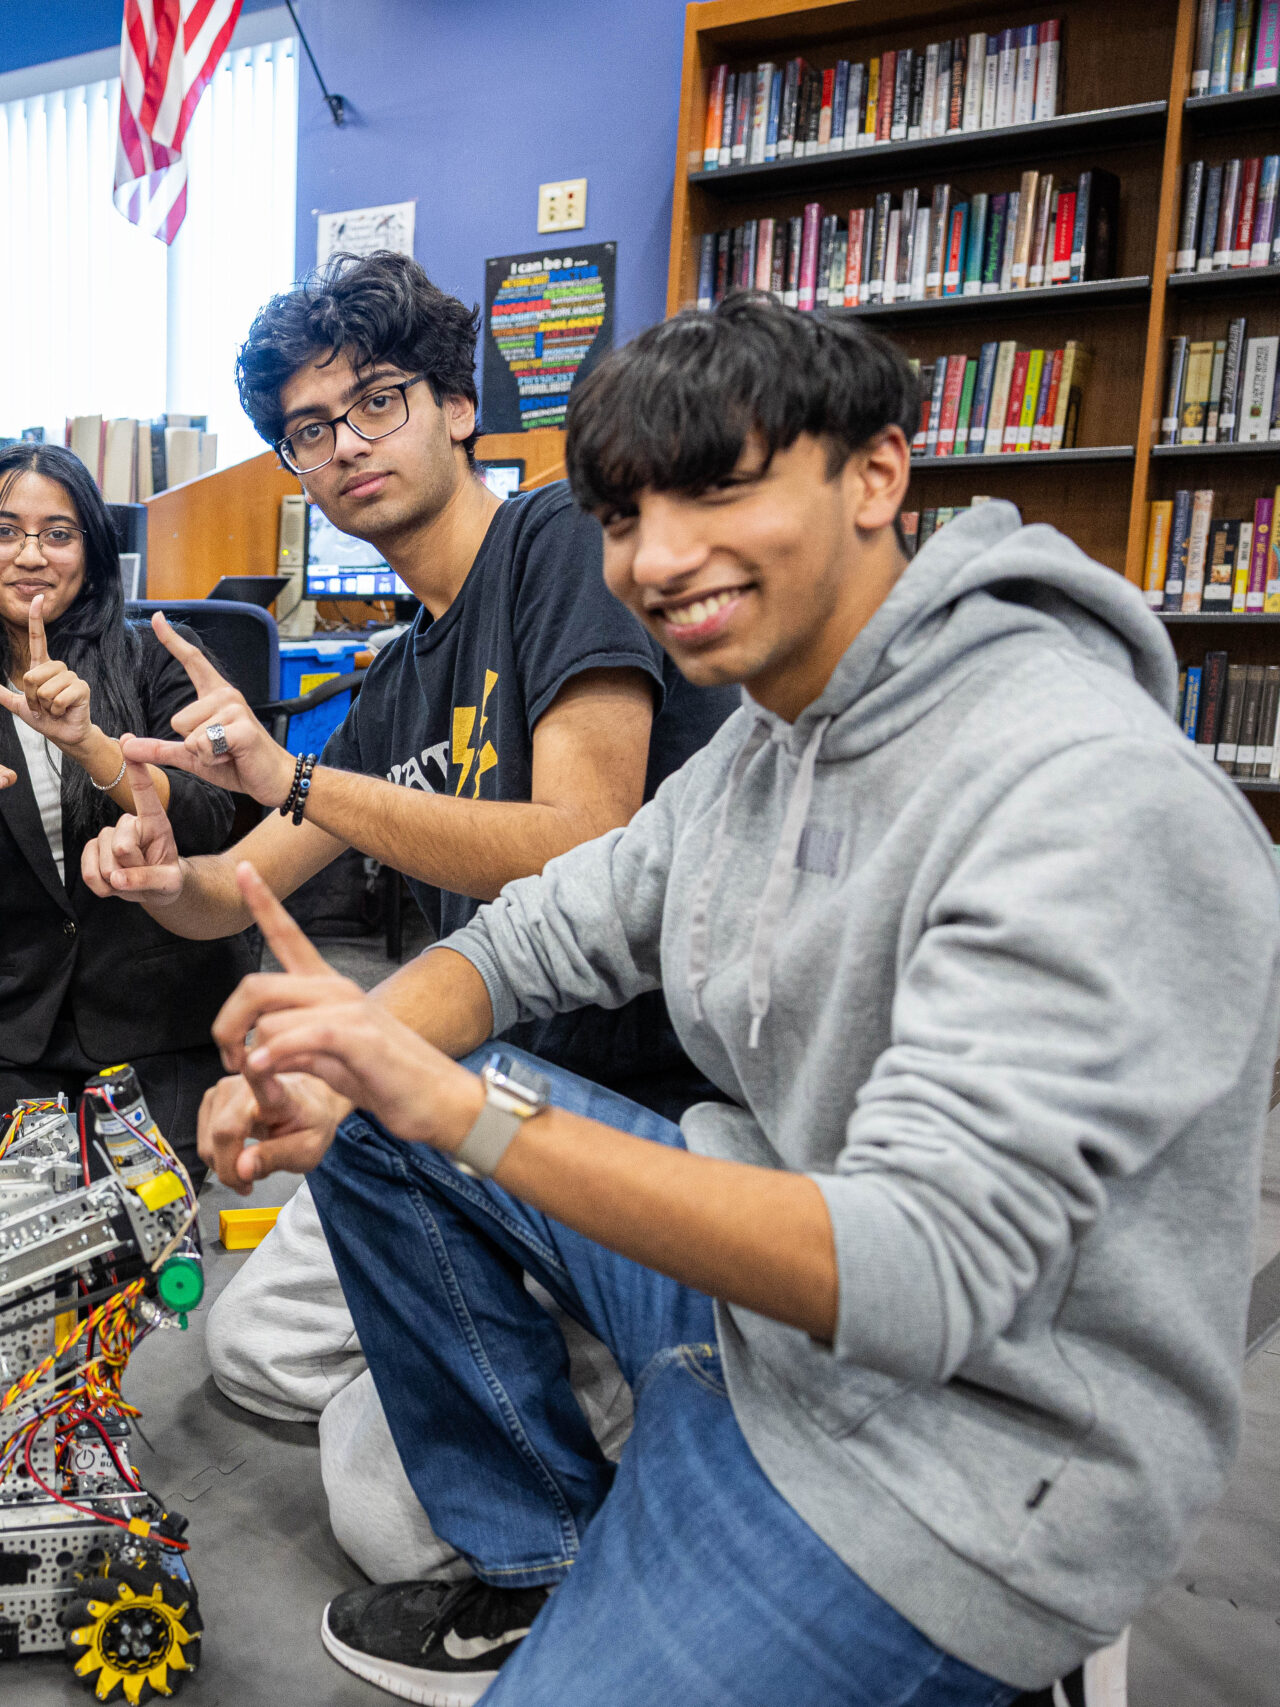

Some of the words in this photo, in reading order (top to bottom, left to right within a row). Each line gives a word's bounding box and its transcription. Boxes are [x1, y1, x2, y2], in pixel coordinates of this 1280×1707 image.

[510, 262, 518, 275] I
[518, 261, 543, 274] can
[543, 257, 562, 271] be
[563, 257, 573, 269] a
[387, 741, 450, 794] AT
